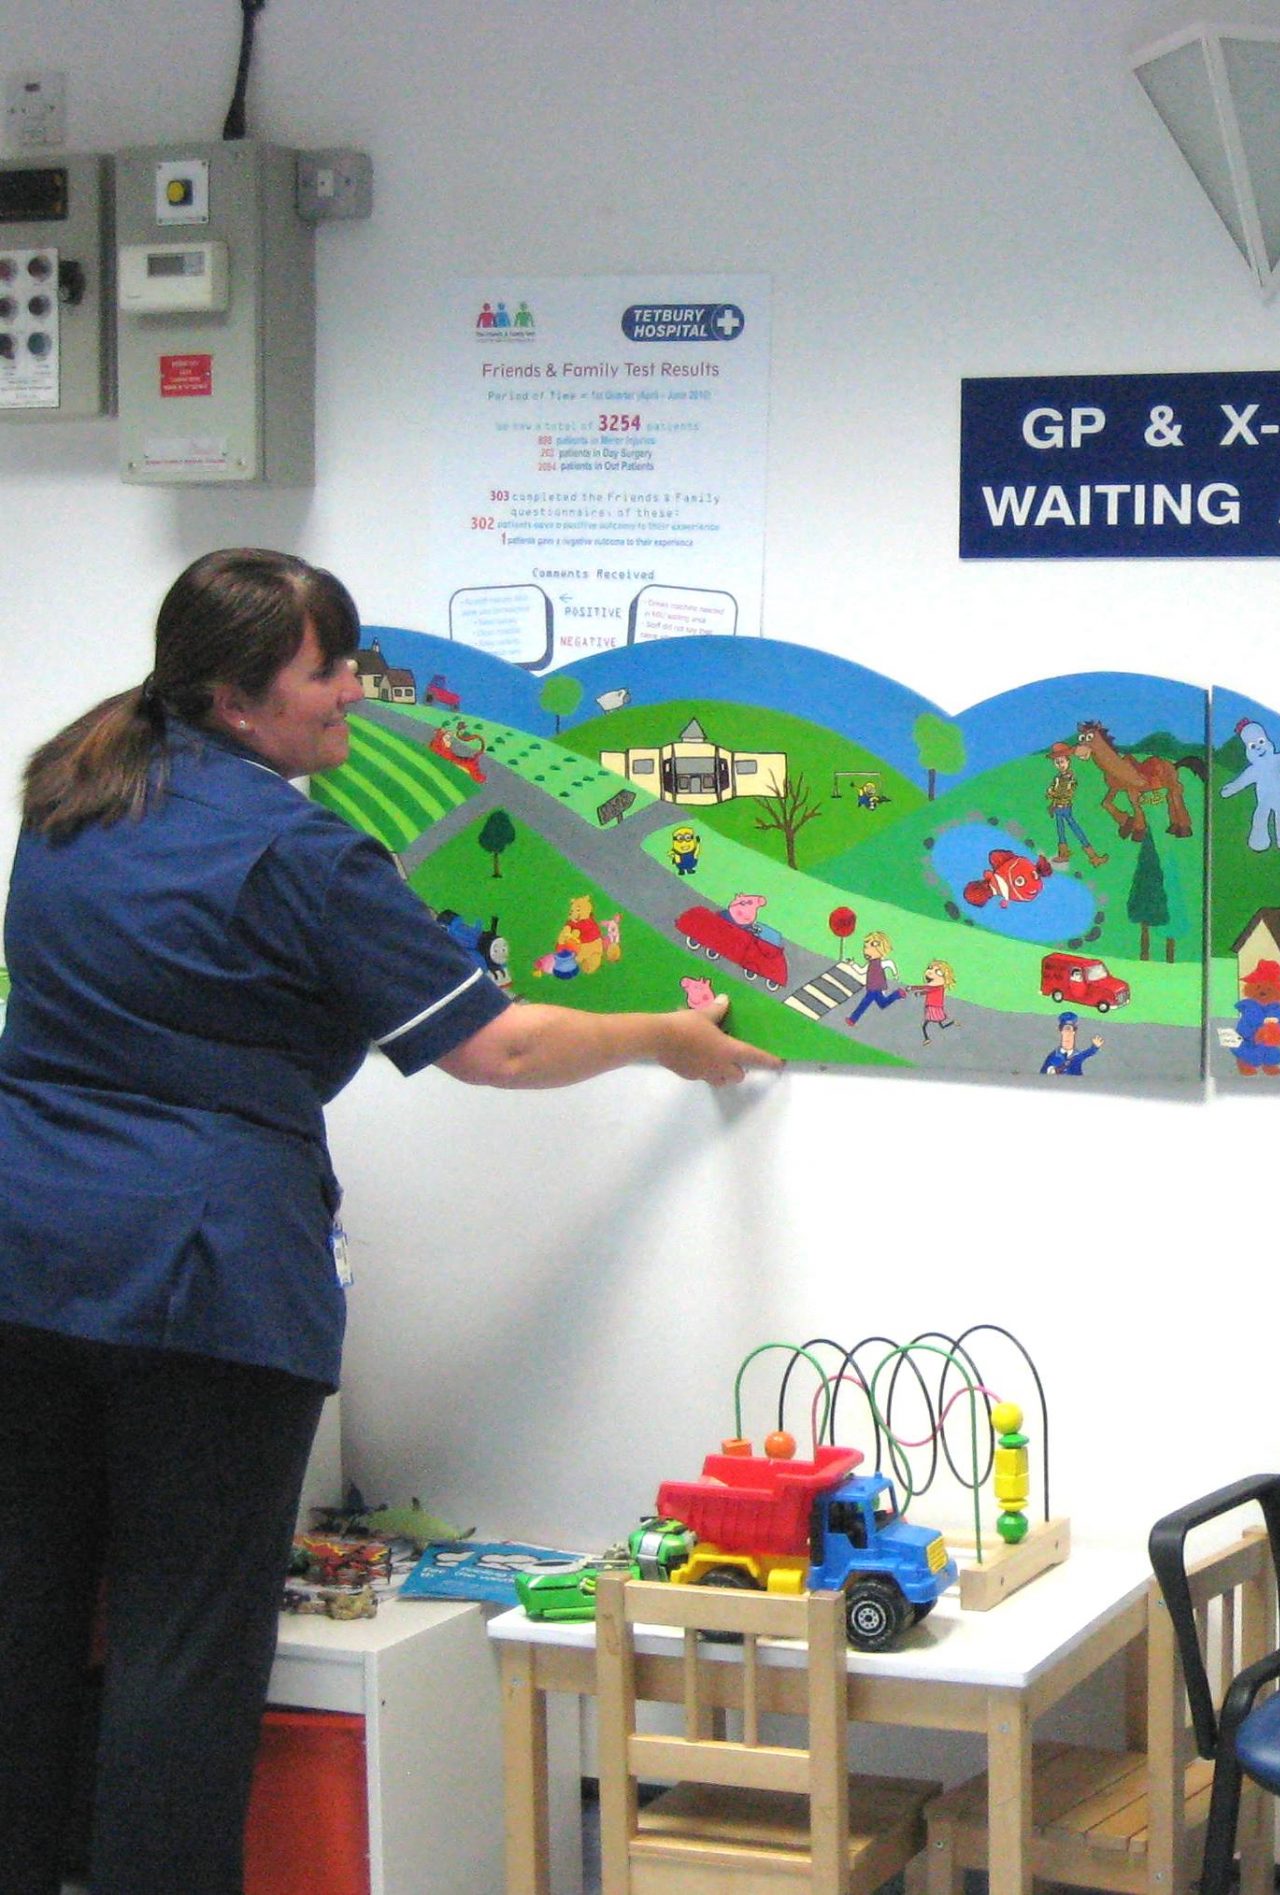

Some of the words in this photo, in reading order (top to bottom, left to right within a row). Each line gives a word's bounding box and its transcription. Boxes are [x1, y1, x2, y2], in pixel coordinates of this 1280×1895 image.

[633, 308, 706, 323] TETBURY
[634, 323, 709, 338] HOSPITAL
[481, 363, 542, 378] Friends
[545, 363, 558, 378] &
[562, 362, 619, 380] Family
[624, 362, 656, 378] Test
[660, 361, 720, 378] Results
[487, 391, 529, 401] Period
[598, 414, 642, 432] 3254
[1021, 407, 1107, 449] GP
[1144, 405, 1184, 448] &
[603, 448, 620, 460] Day
[623, 448, 653, 461] Surgery
[489, 490, 510, 502] 303
[511, 491, 577, 504] completed
[581, 492, 603, 502] the
[607, 492, 659, 503] Friends
[675, 493, 721, 506] Family
[981, 483, 1241, 527] WAITING
[617, 508, 631, 518] of
[470, 517, 495, 530] 302
[531, 568, 589, 580] Comments
[596, 568, 656, 580] Received
[564, 607, 622, 619] POSITIVE
[559, 636, 617, 648] NEGATIVE
